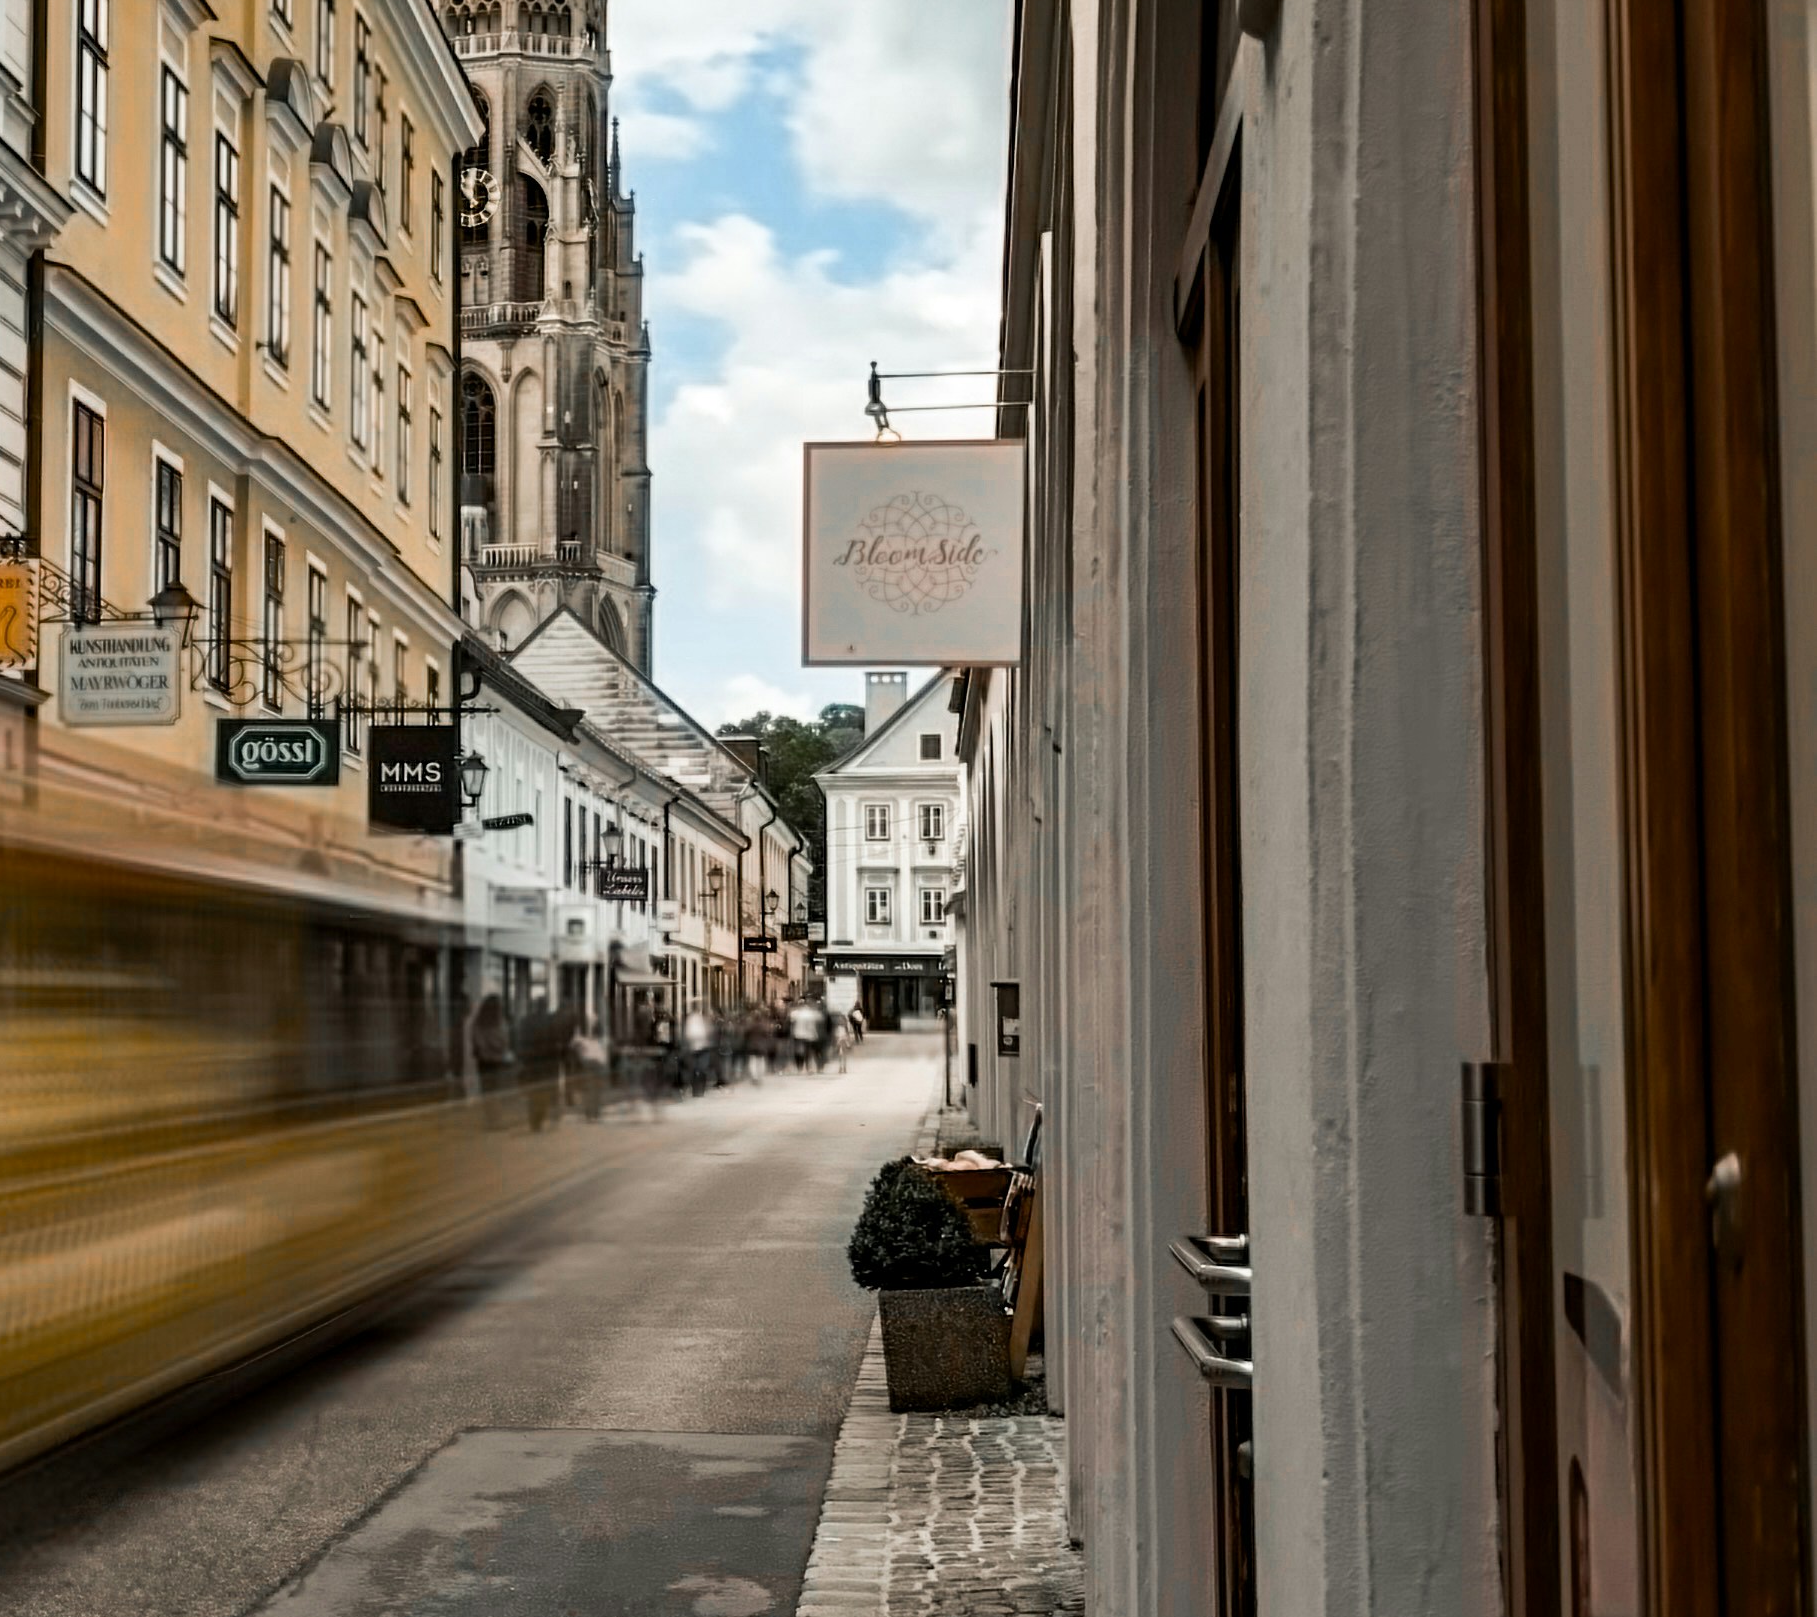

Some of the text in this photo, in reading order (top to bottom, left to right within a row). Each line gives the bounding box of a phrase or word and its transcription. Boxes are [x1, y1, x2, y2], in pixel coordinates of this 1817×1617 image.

[70, 637, 171, 655] KUNSTHANDLUNG
[241, 737, 313, 770] gössl
[381, 762, 441, 783] MMS
